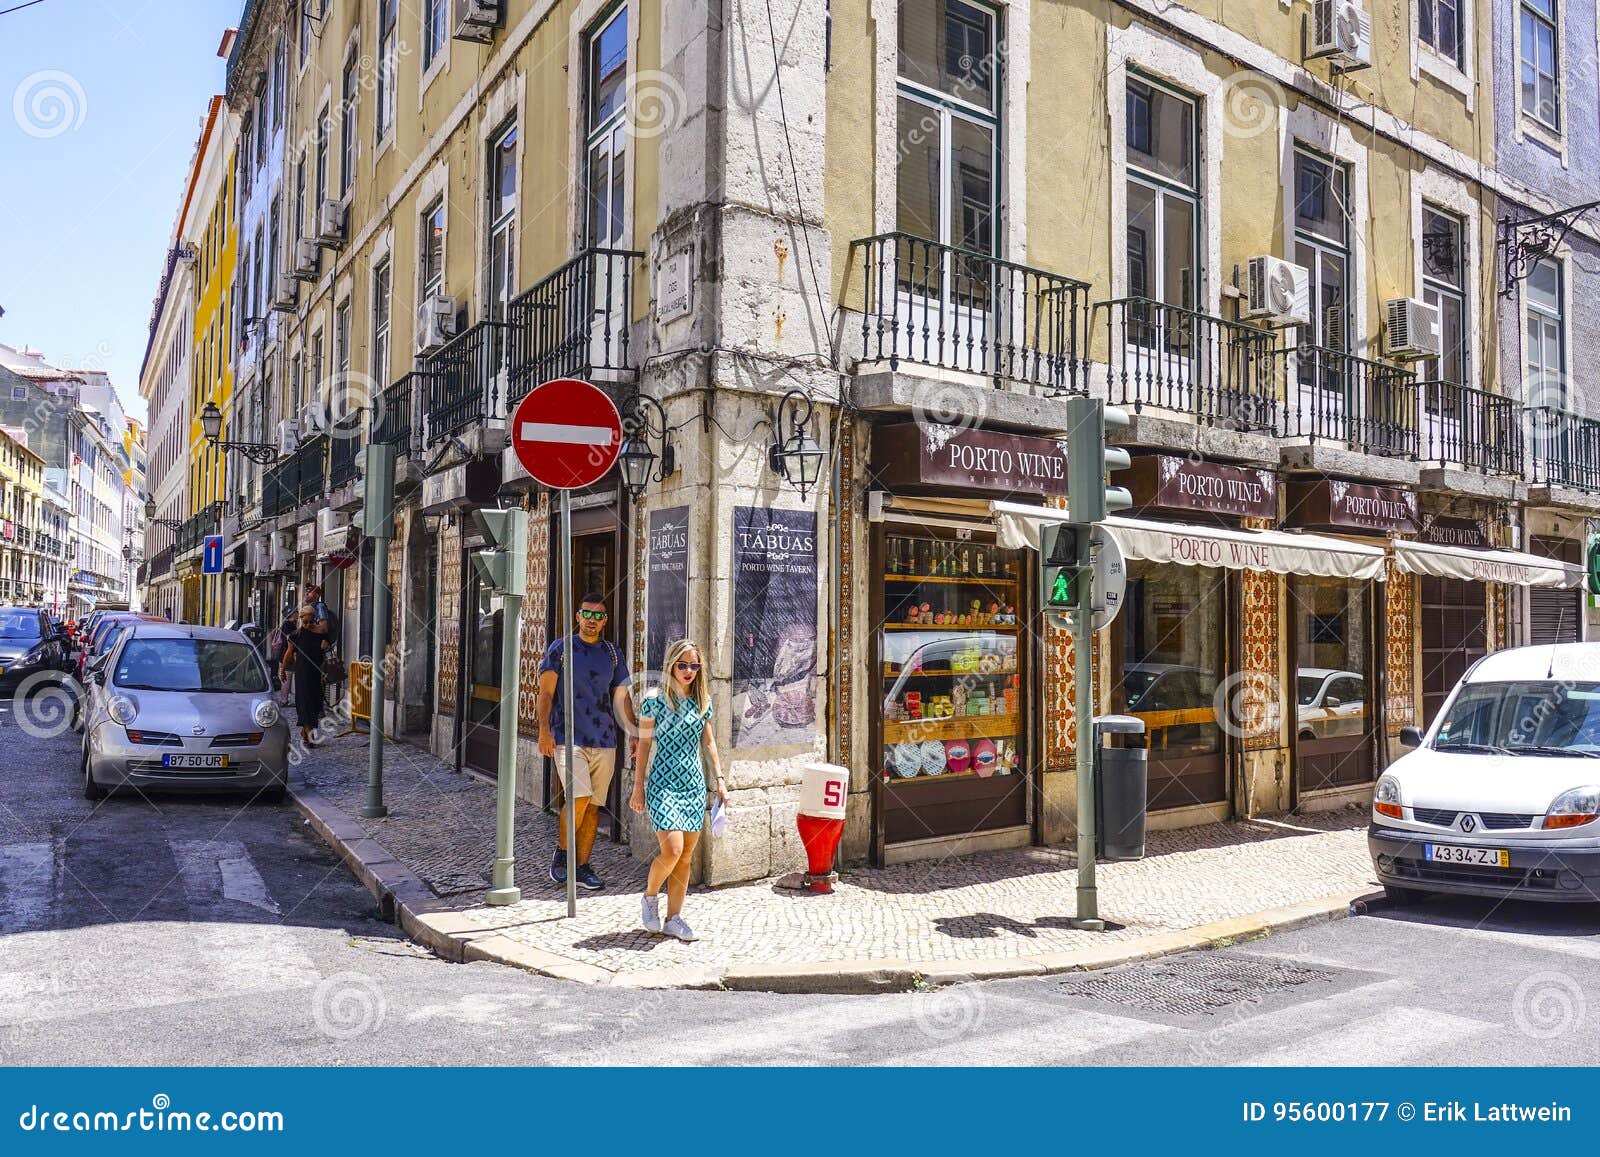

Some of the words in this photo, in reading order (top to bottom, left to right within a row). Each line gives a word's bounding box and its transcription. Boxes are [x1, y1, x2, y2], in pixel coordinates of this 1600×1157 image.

[949, 443, 1013, 474] PORTO
[1017, 452, 1065, 480] WINE
[1178, 473, 1224, 499] PORTO
[1227, 480, 1263, 503] WINE
[1345, 495, 1380, 518] PORTO
[1381, 500, 1407, 521] WINE
[651, 532, 687, 551] TÁBUAS
[739, 530, 814, 552] TÁBUAS
[1430, 525, 1456, 544] PORTO
[1457, 529, 1481, 546] WINE
[1169, 536, 1222, 563] PORTO
[1229, 543, 1270, 568] WINE
[742, 562, 766, 573] PORTO
[767, 563, 786, 573] WINE
[786, 564, 813, 574] TAVERN
[1471, 560, 1502, 579] PORTO
[1505, 563, 1530, 582] WINE
